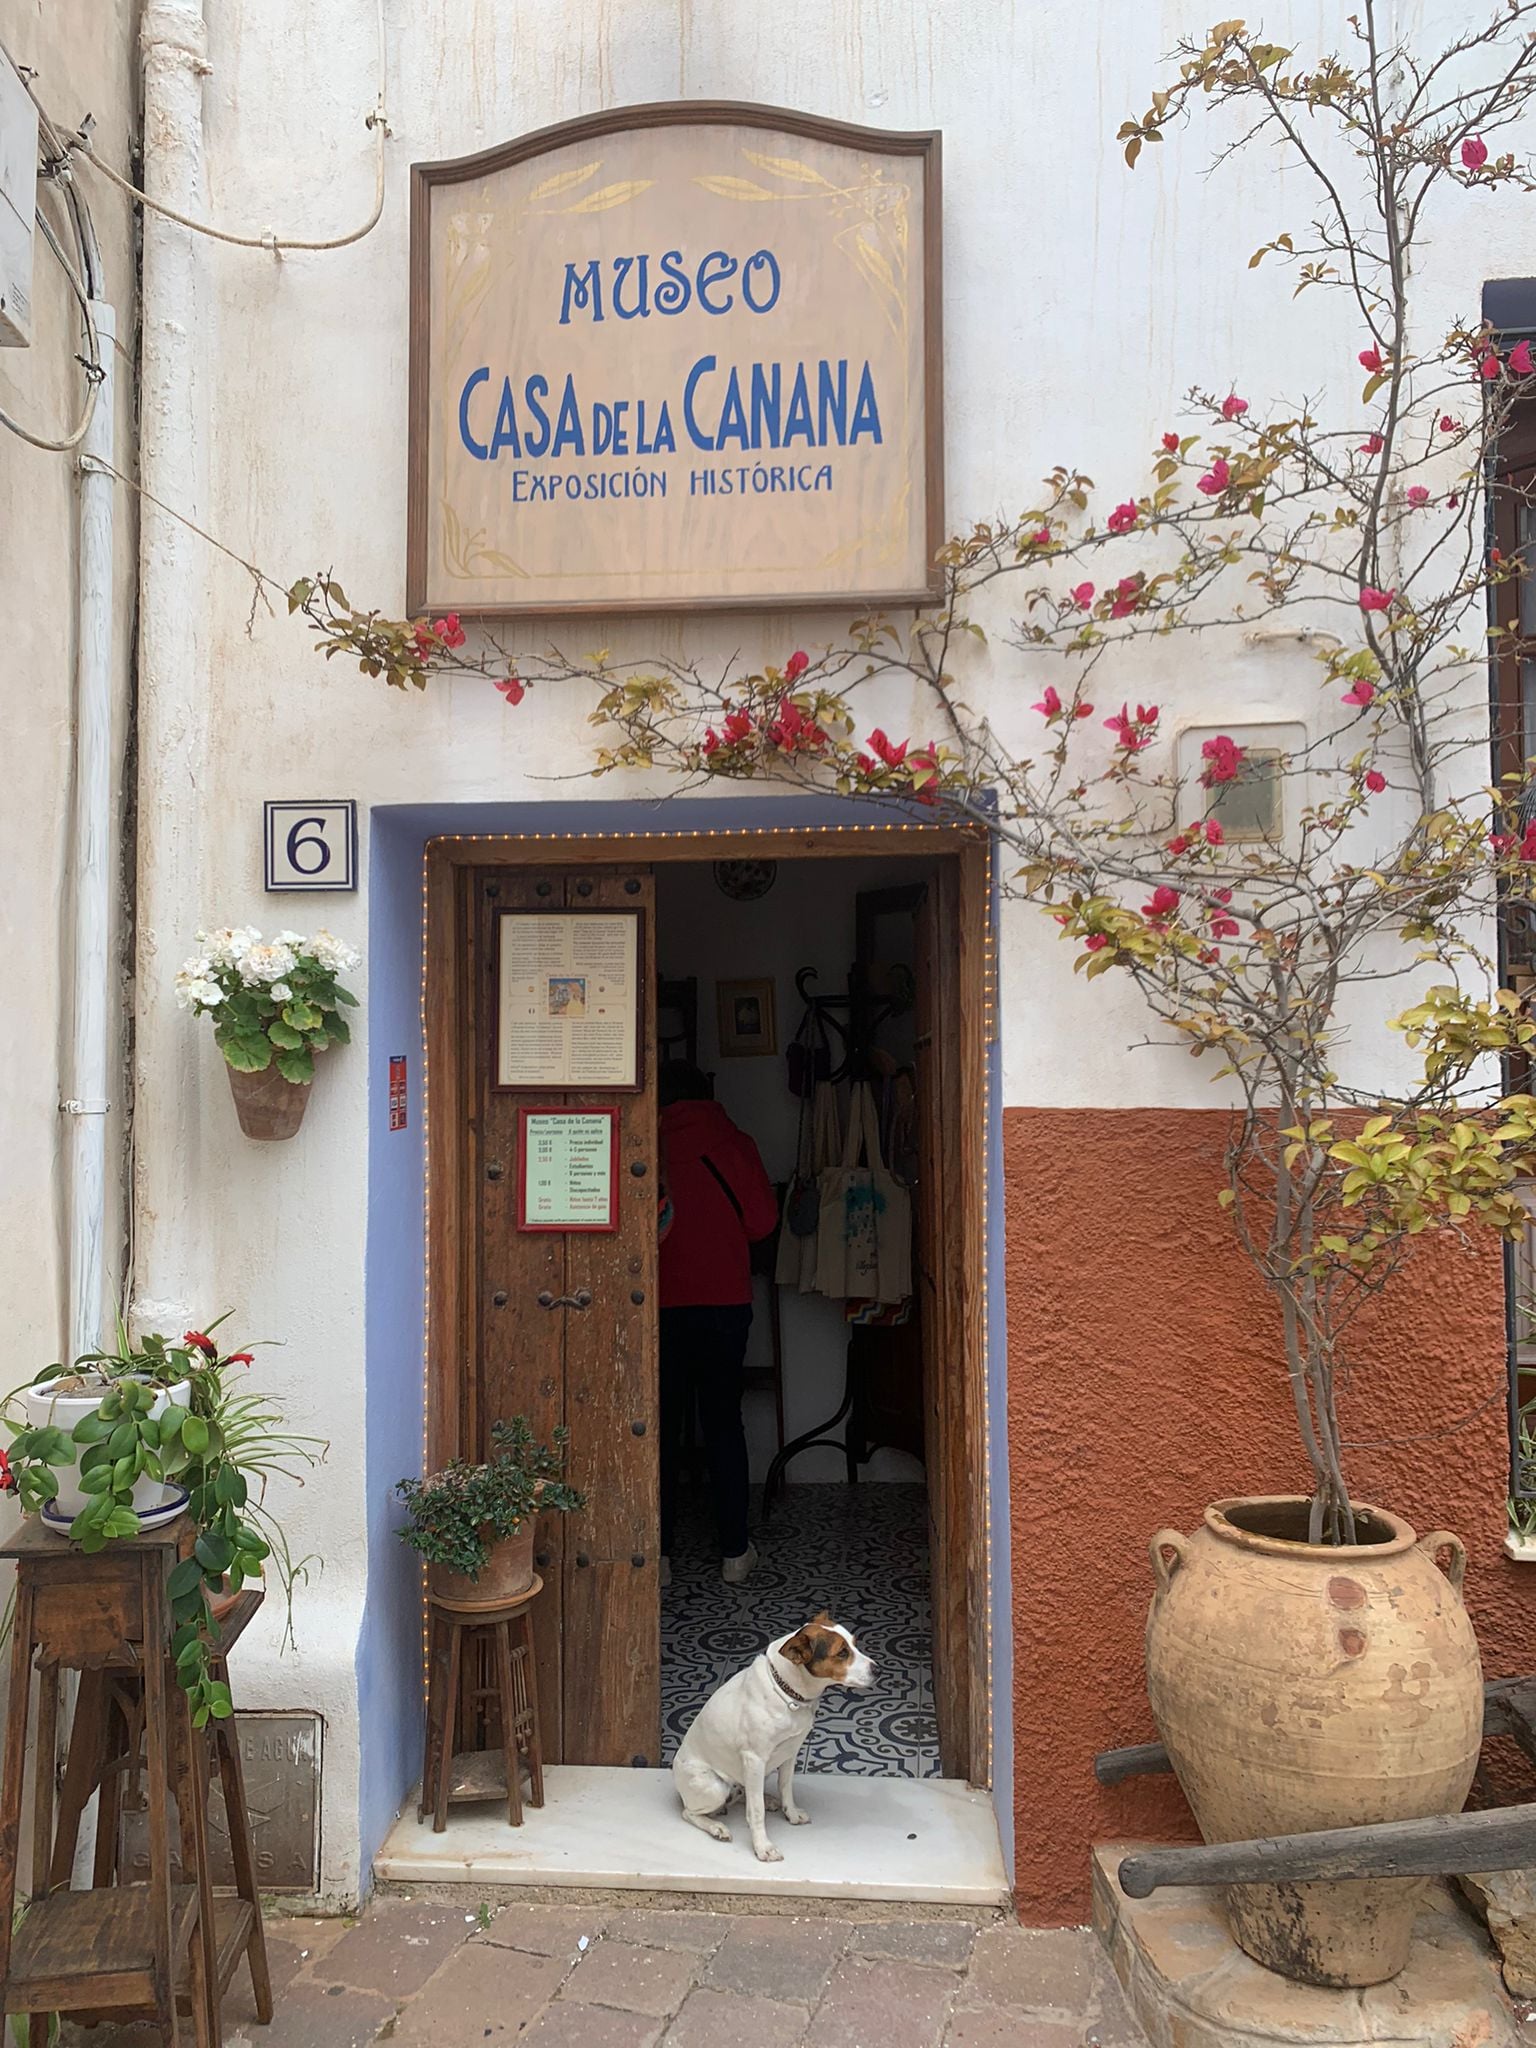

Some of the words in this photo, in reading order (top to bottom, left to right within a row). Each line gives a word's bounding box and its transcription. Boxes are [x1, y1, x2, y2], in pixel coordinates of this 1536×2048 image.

[458, 366, 586, 461] CASA
[592, 399, 630, 456] DE
[636, 399, 677, 455] LA
[683, 355, 884, 452] CANANA
[512, 465, 668, 503] EXPOSICIÓN
[690, 461, 834, 496] HISTÓRICA
[286, 817, 331, 875] 6
